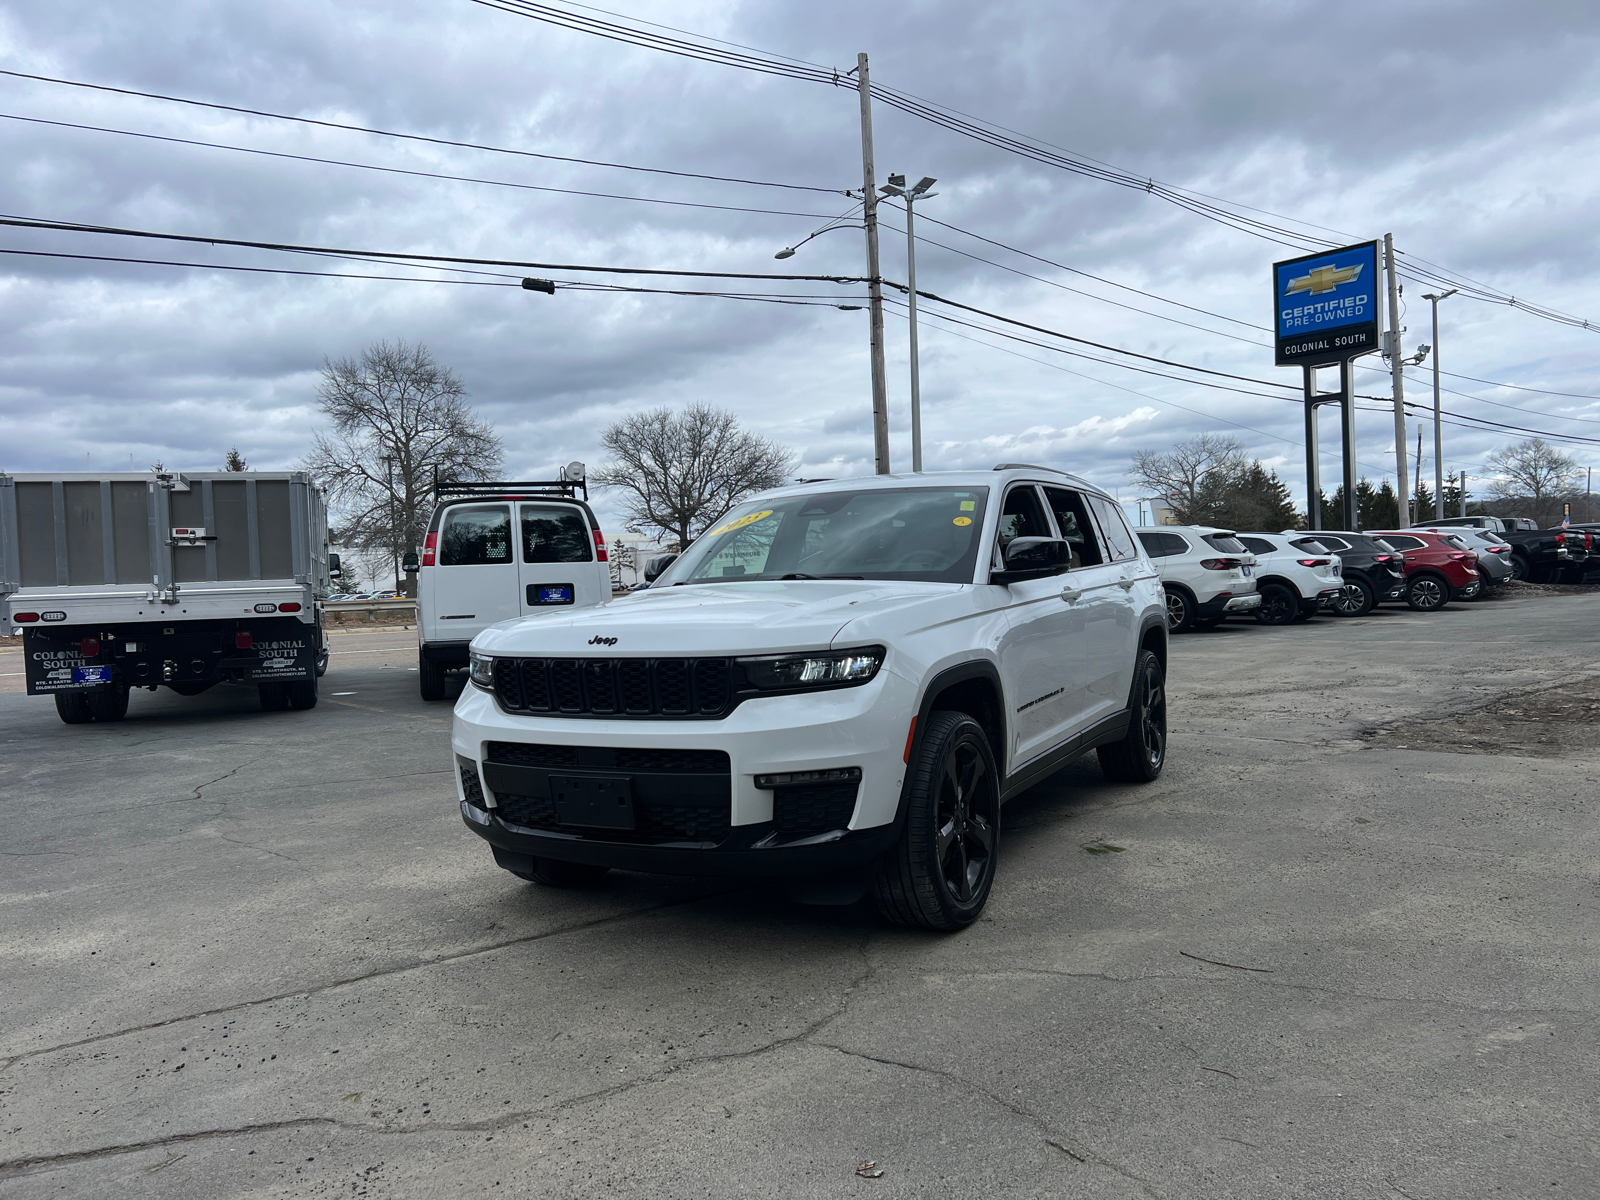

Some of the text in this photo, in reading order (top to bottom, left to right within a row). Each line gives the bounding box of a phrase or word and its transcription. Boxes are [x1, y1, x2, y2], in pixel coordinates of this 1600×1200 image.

[1282, 294, 1368, 319] CERTIFIED
[1286, 306, 1363, 328] PRE-OWNED
[1285, 333, 1366, 355] COLONIAL SOUTH
[716, 512, 763, 534] 2023
[724, 551, 761, 559] WAEHOUSE
[251, 640, 305, 650] COLONIAL
[587, 635, 619, 647] Jeep
[33, 651, 84, 660] COLONI
[259, 649, 298, 658] SOUTH
[43, 660, 85, 669] SOUTH
